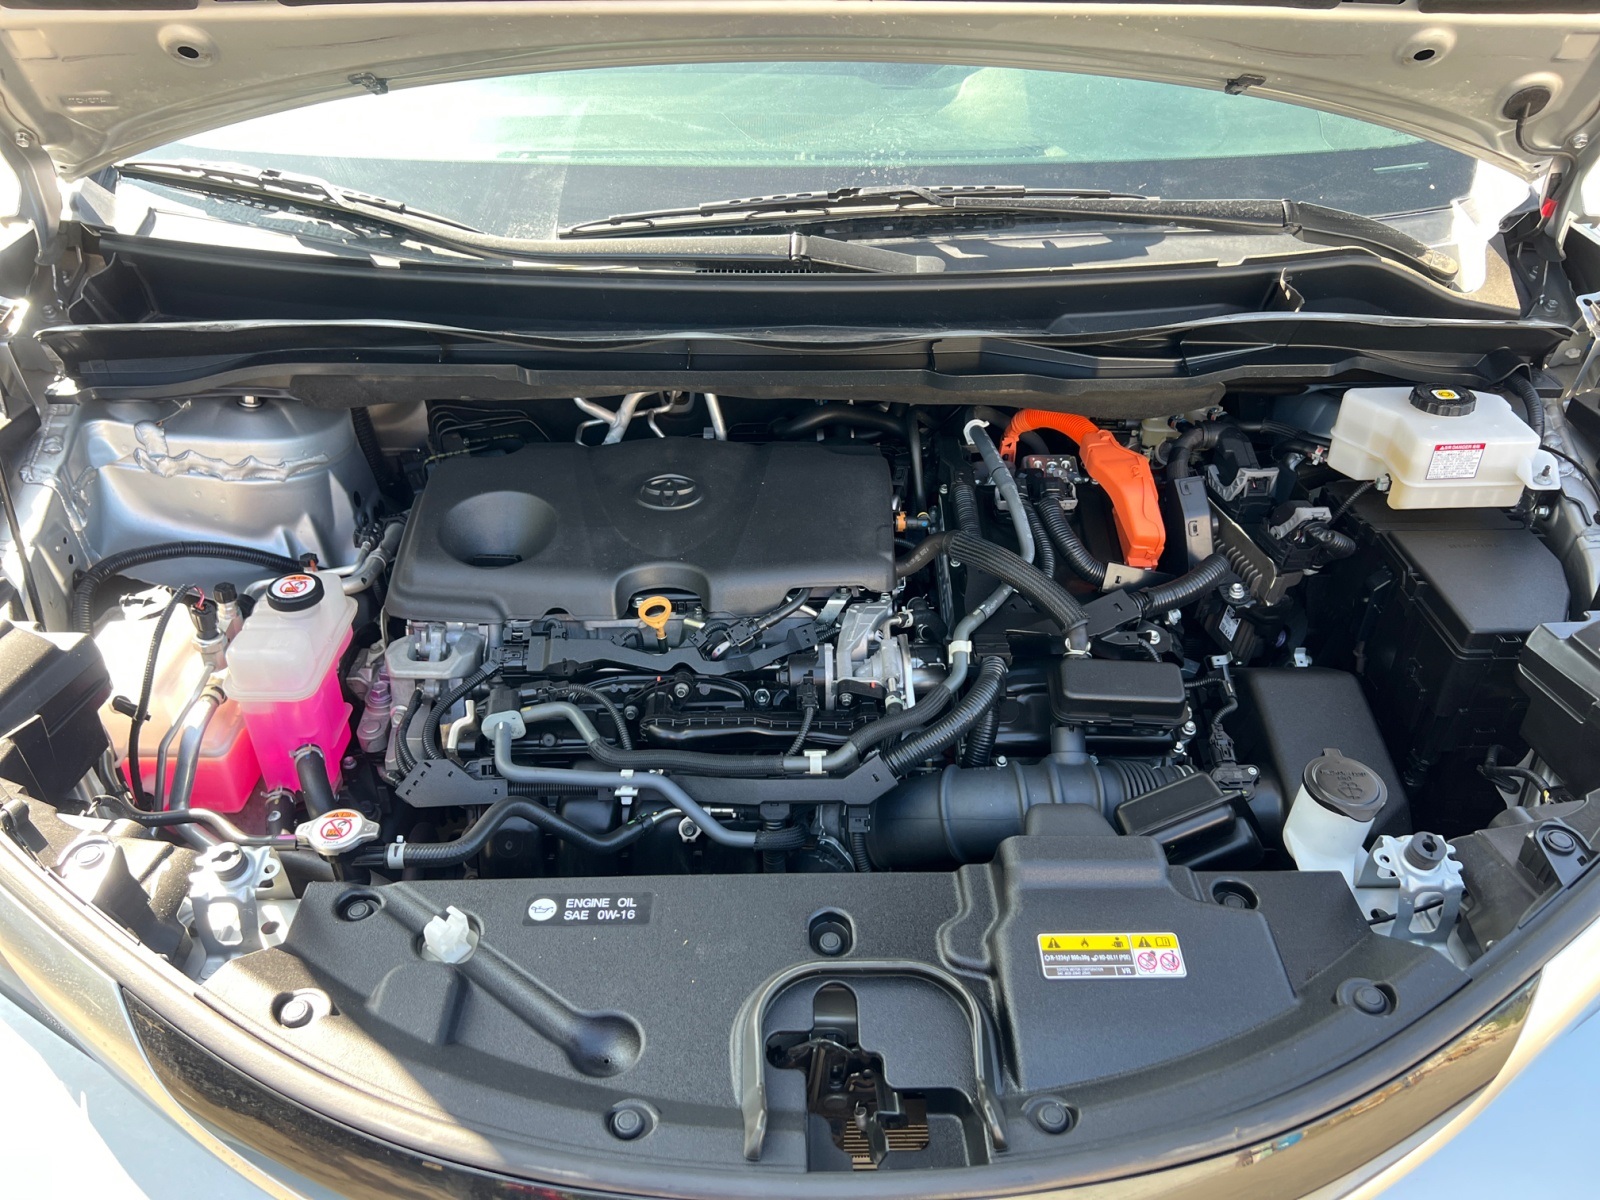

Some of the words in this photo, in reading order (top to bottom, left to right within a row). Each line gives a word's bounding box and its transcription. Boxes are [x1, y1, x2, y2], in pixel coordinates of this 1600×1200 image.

[565, 898, 610, 908] ENGINE
[617, 897, 637, 908] OIL
[563, 910, 589, 920] SAE
[597, 909, 635, 920] 0W-16
[1121, 967, 1132, 975] VR
